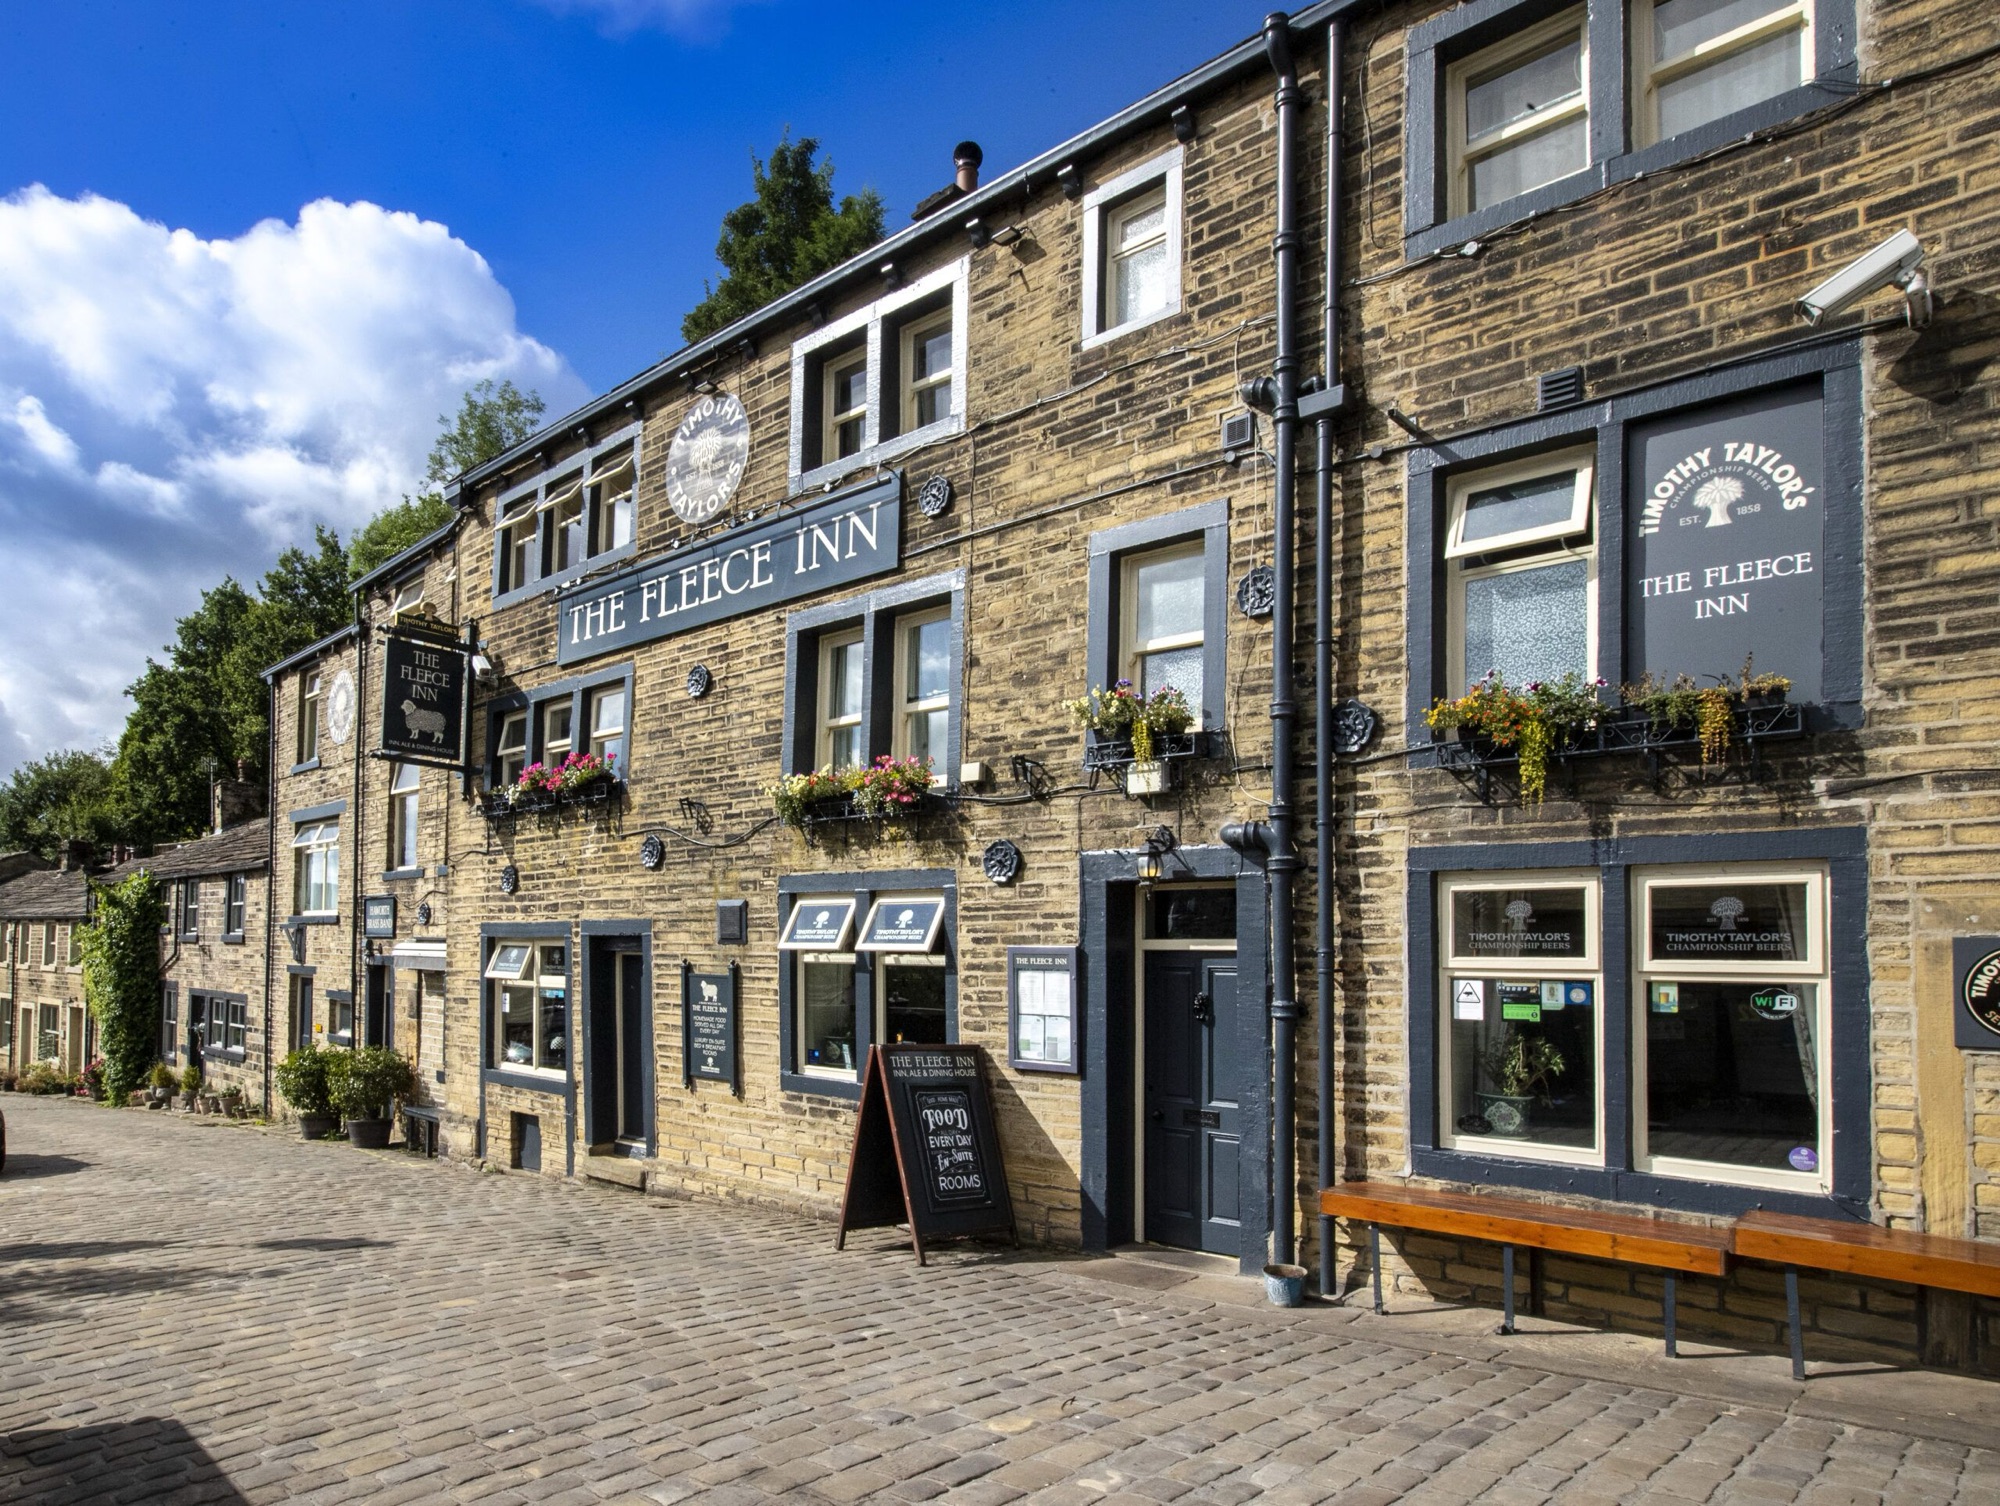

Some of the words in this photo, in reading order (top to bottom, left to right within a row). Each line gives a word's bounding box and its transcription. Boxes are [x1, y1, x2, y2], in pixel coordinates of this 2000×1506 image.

[674, 398, 743, 447] TIMOTHY
[672, 461, 741, 517] TAYLOR'S
[1638, 446, 1711, 538] TIMOTHY
[1723, 442, 1816, 511] TAYLOR'S
[1670, 465, 1744, 509] CHAMPIONSHIP
[1746, 469, 1772, 491] BEERS
[1679, 514, 1702, 527] EST.
[1736, 503, 1761, 515] 1858
[569, 591, 626, 644] THE
[639, 540, 774, 624] FLEECE
[794, 501, 882, 575] INN
[1639, 571, 1692, 597] THE
[1703, 552, 1813, 588] FLEECE
[1695, 592, 1750, 619] INN
[400, 616, 428, 628] TIMOTHY
[430, 622, 458, 635] TAYLOR'S
[413, 650, 440, 669] THE
[400, 664, 450, 688] FLEECE
[411, 684, 438, 702] INN
[1468, 932, 1518, 941] TIMOTHY
[1519, 932, 1571, 941] TAYLOR'S
[1468, 941, 1540, 950] CHAMPIONSHIP
[1542, 941, 1571, 950] BEERS
[1666, 932, 1728, 942] TIMOTHY
[1728, 932, 1791, 942] TAYLOR'S
[1666, 943, 1753, 951] CHAMPIONSHIP
[1756, 943, 1792, 951] BEERS
[1015, 957, 1028, 965] THE
[1030, 957, 1053, 965] FLEECE
[1054, 957, 1067, 965] INN
[692, 1004, 701, 1012] THE
[702, 1005, 719, 1013] FLEECE
[890, 1056, 912, 1067] THE
[914, 1056, 953, 1067] FLEECE
[956, 1056, 975, 1067] INN
[909, 1069, 922, 1077] ALE
[922, 1069, 928, 1077] &
[928, 1069, 953, 1077] DINING
[954, 1069, 977, 1077] HOUSE
[922, 1108, 968, 1133] FOOD
[928, 1136, 955, 1148] EVERY
[956, 1135, 971, 1146] DAY
[938, 1174, 981, 1191] ROOMS
